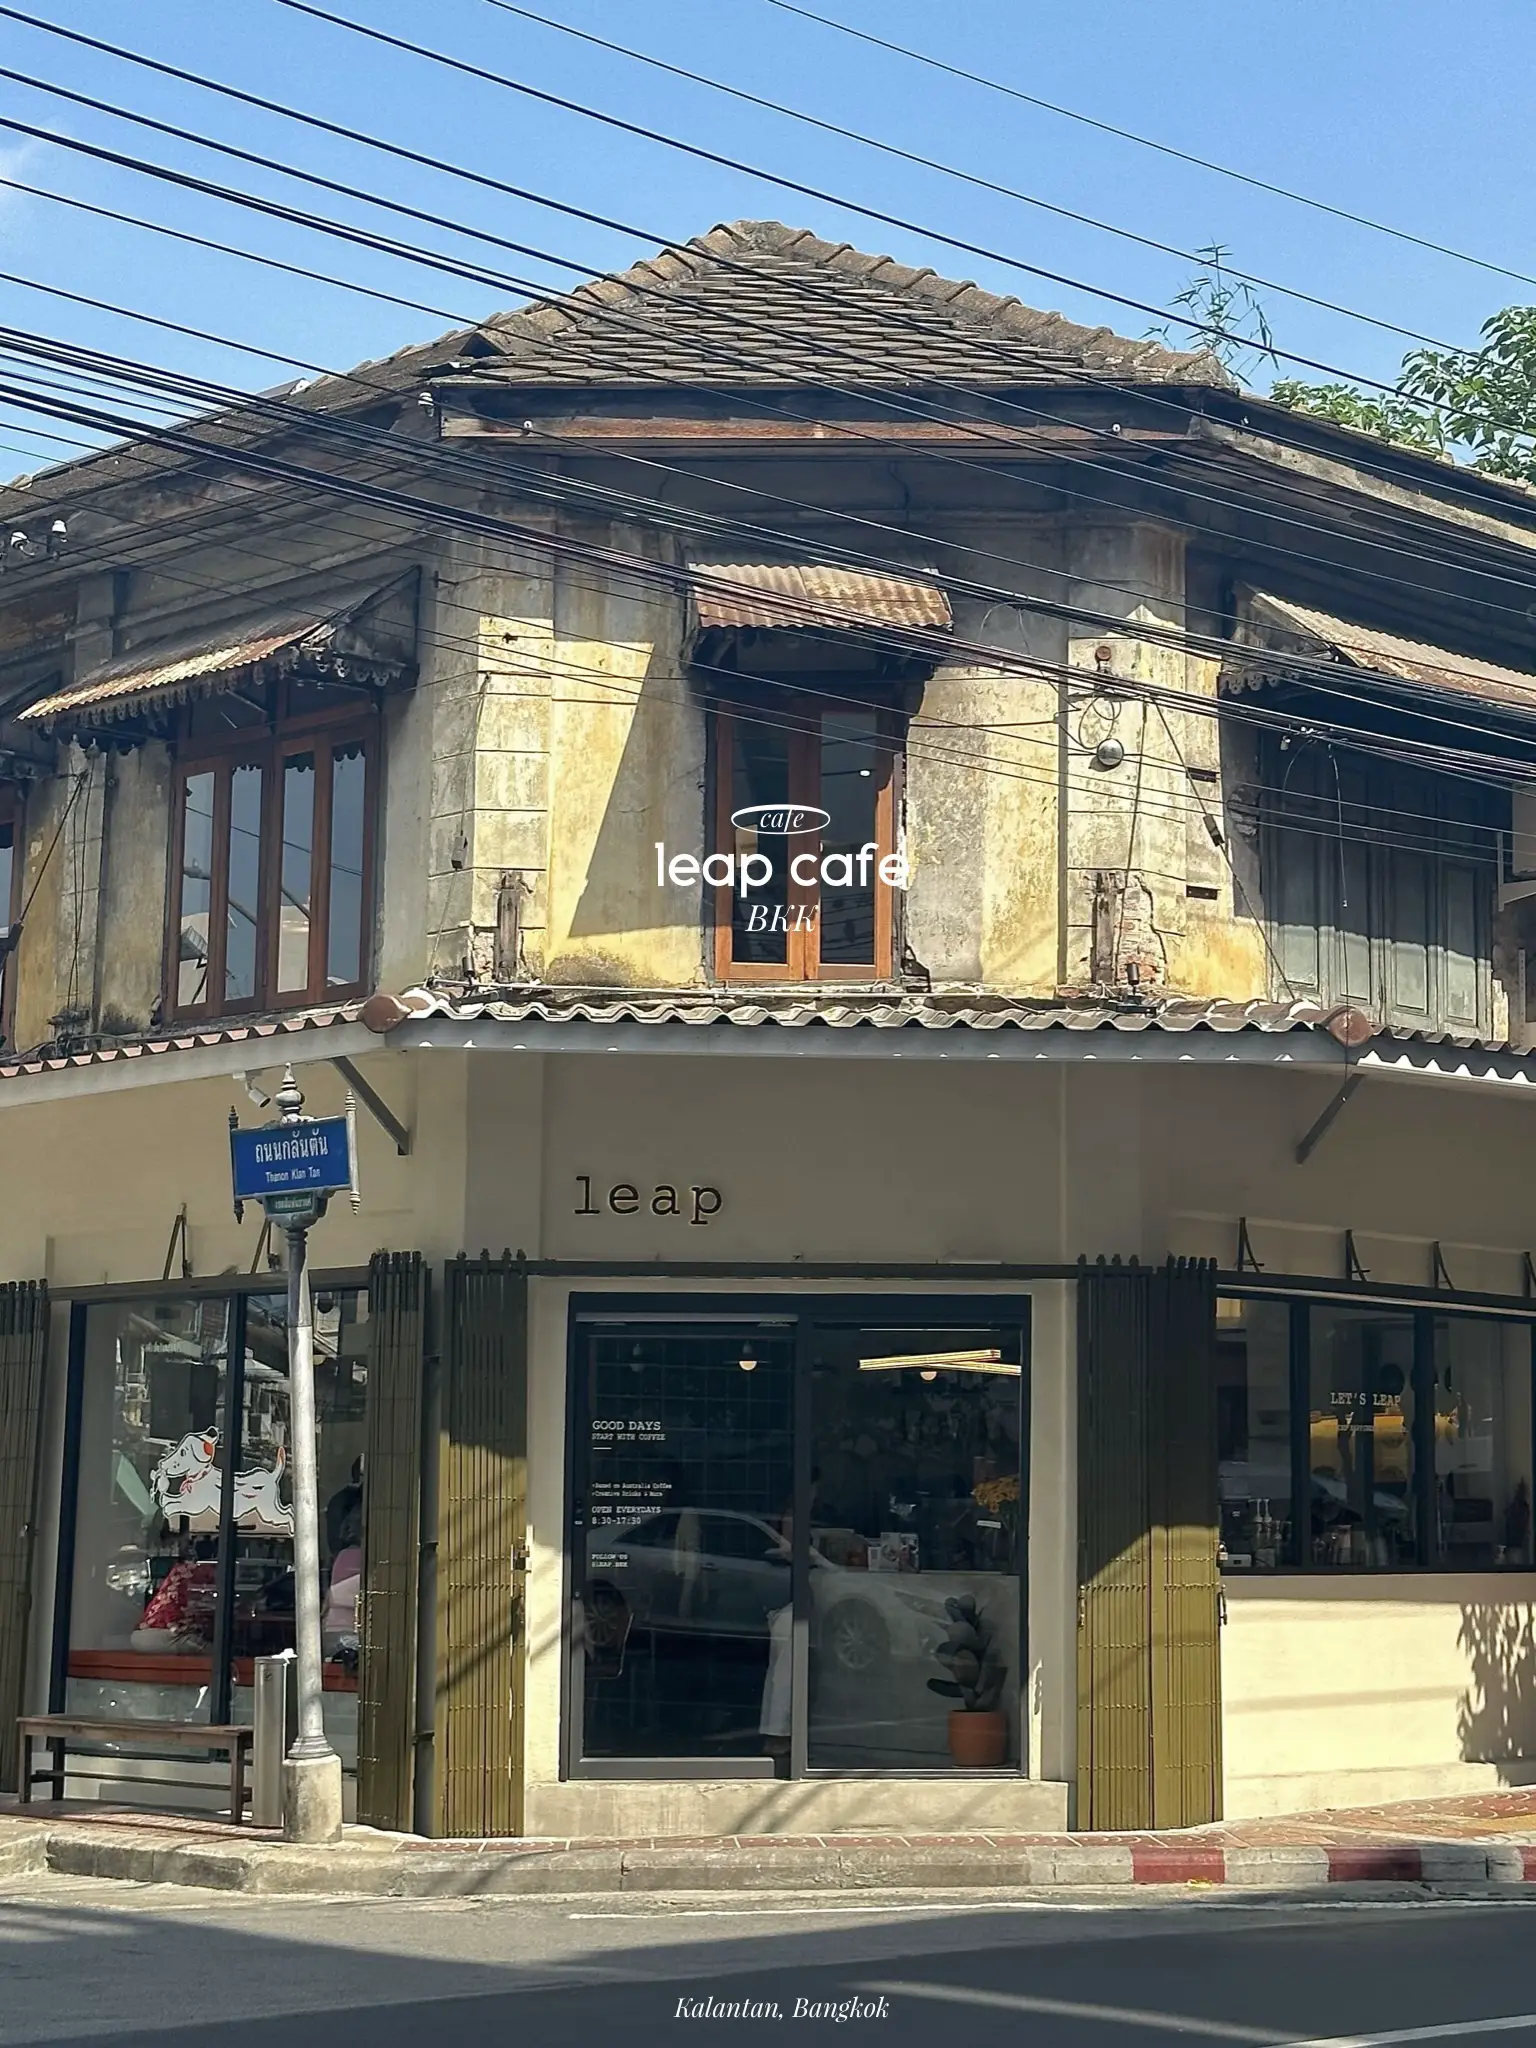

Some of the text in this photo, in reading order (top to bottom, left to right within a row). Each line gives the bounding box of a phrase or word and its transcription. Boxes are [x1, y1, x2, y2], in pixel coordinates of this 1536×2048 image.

[255, 1128, 328, 1163] ถนนกลันตัน
[265, 1171, 289, 1183] Thanon
[308, 1166, 321, 1178] Tan
[574, 1175, 722, 1225] leap
[1330, 1392, 1401, 1406] LET'S LEAP
[592, 1420, 662, 1431] GOOD DAYS
[592, 1433, 667, 1441] START WITH COFFEE
[591, 1506, 662, 1514] OPEN EVERYDAYS
[591, 1517, 642, 1525] 8:30-17:30
